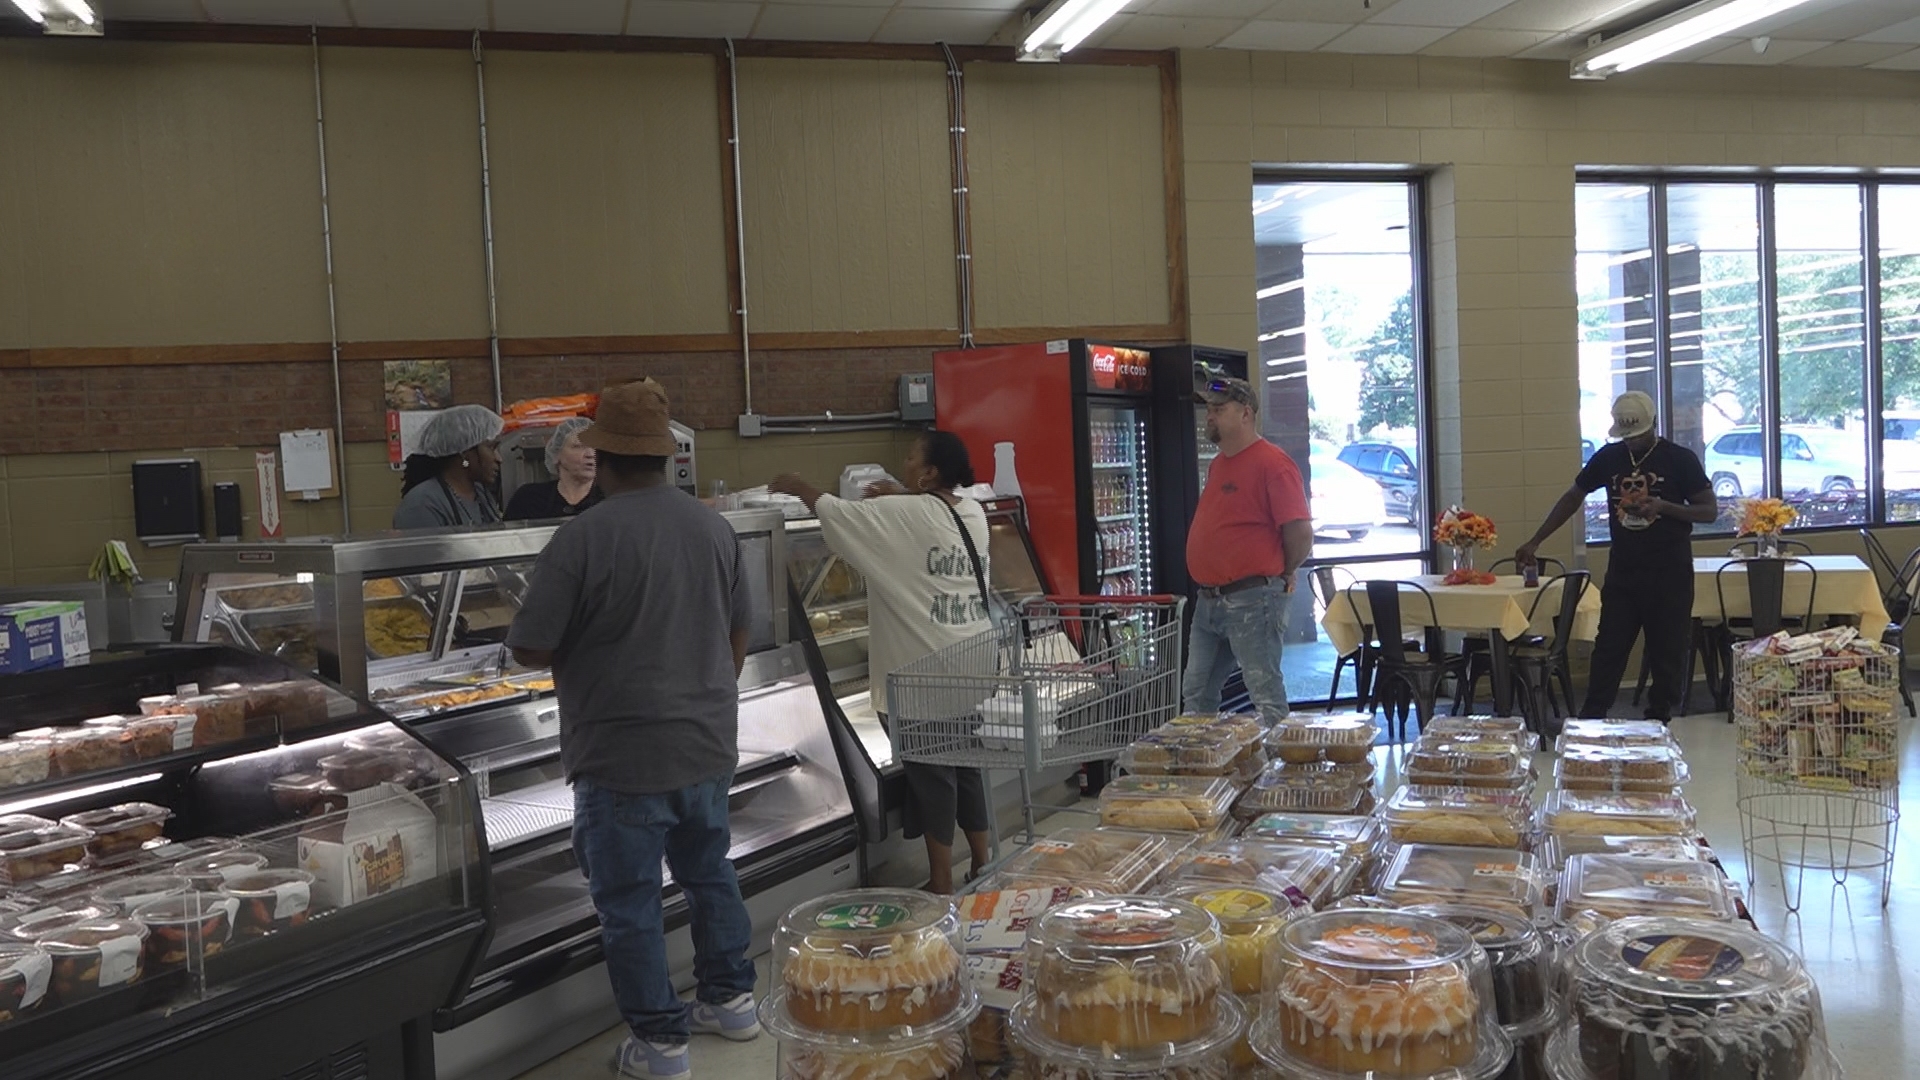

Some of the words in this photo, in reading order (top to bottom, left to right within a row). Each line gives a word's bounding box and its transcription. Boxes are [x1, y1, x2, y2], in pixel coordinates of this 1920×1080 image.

[1117, 364, 1129, 375] ICE
[1130, 365, 1147, 376] COLD
[926, 545, 956, 576] God
[930, 593, 949, 624] All
